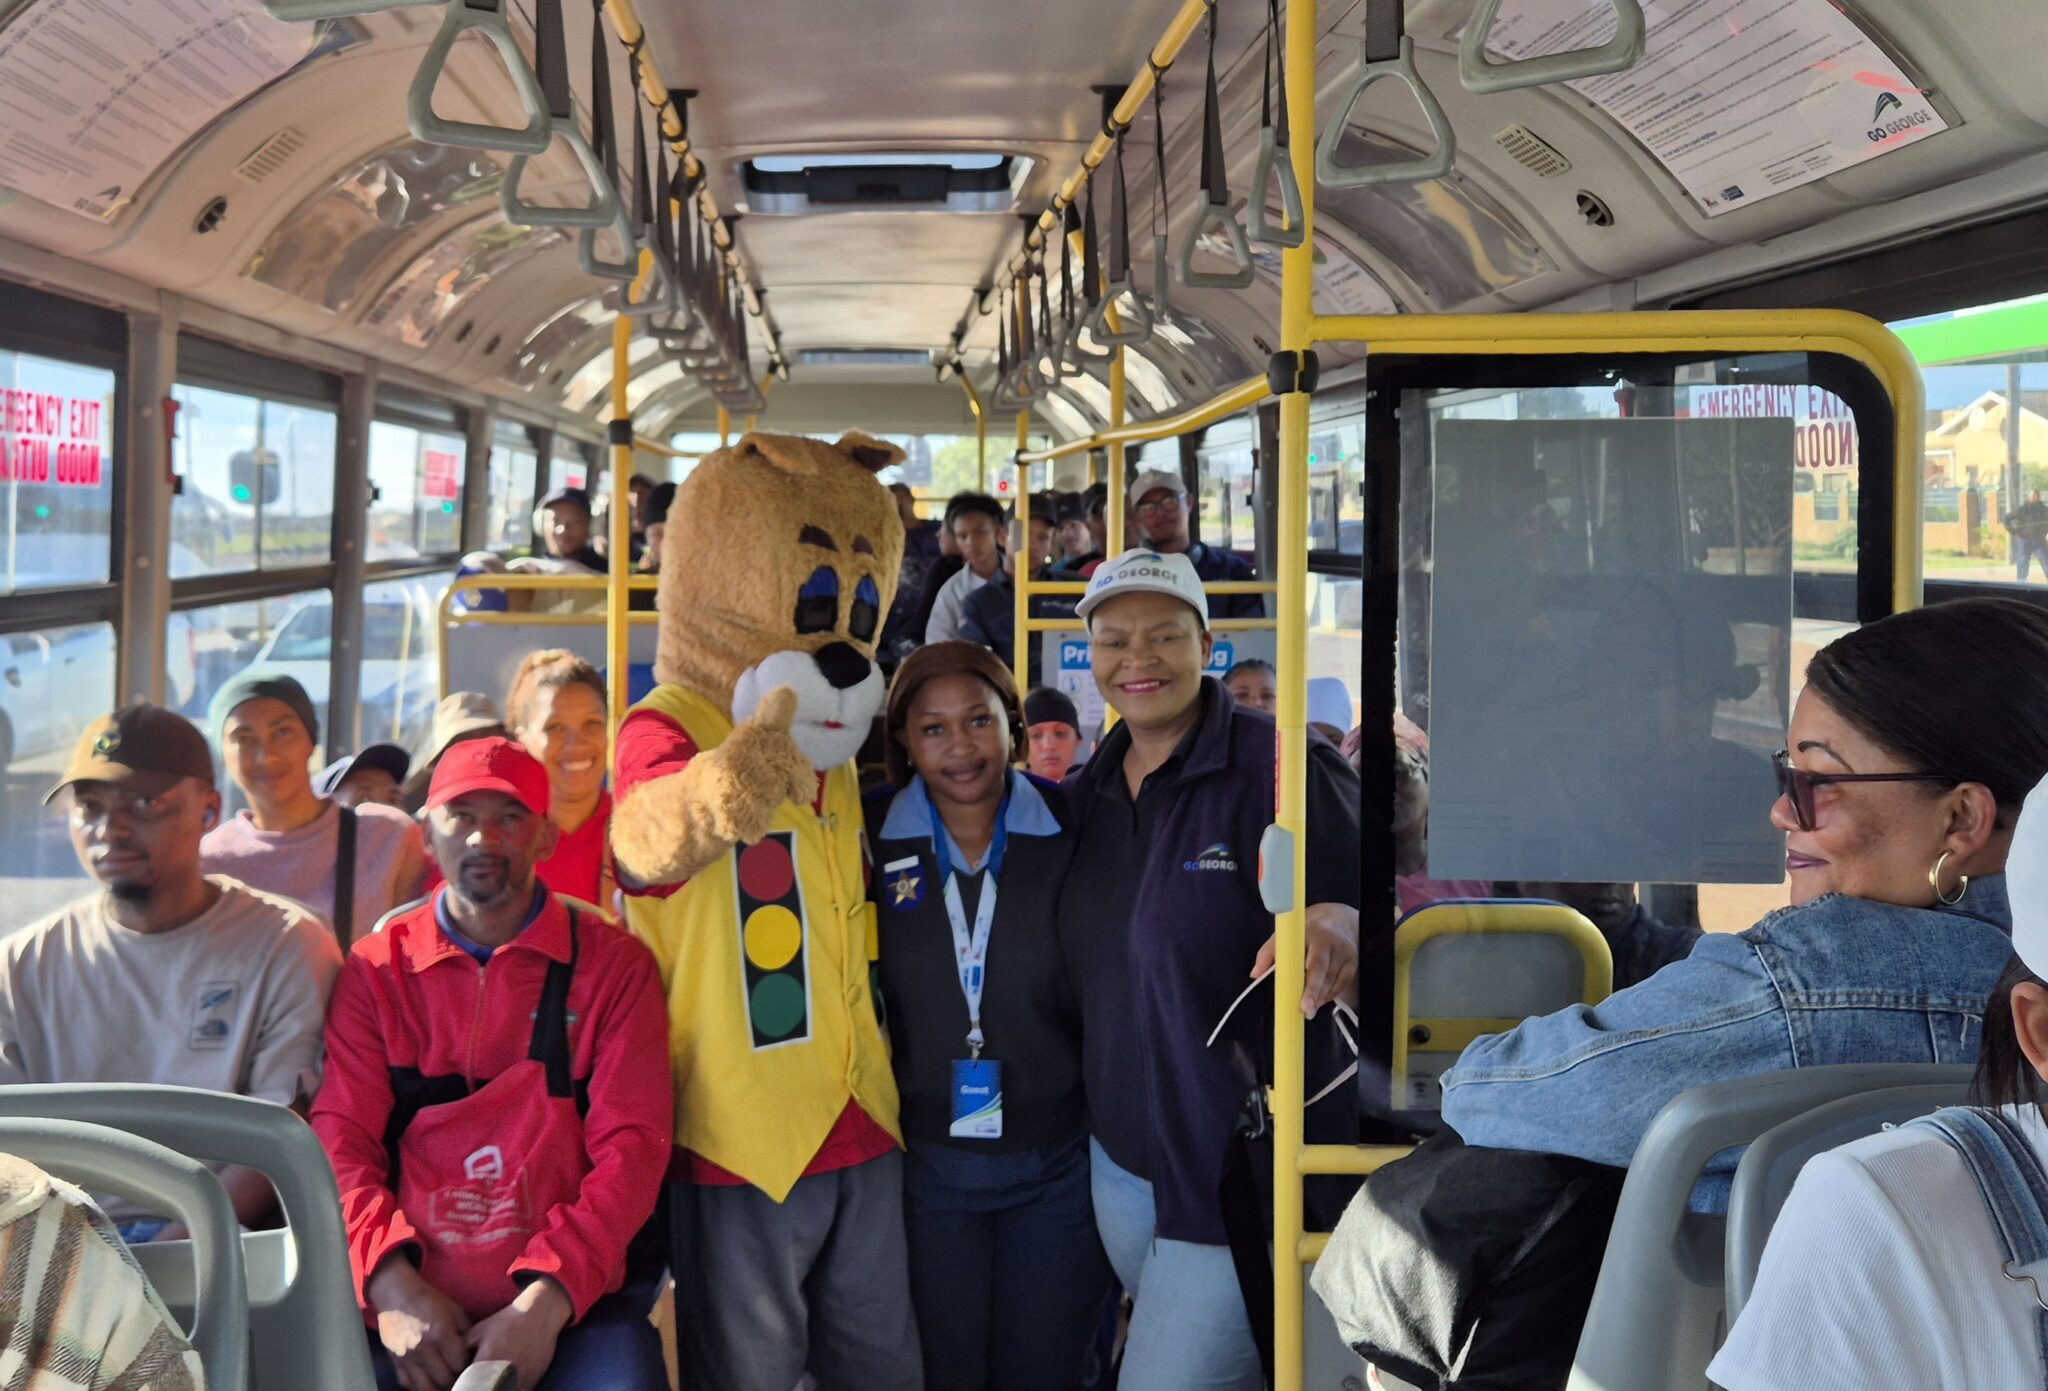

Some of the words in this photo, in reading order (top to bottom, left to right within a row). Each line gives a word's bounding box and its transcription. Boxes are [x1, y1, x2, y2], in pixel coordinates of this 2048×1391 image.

[1867, 127, 1887, 142] GO
[1886, 109, 1932, 135] GEORGE
[70, 399, 101, 440] EXIT
[1095, 575, 1114, 589] GO
[1118, 567, 1179, 585] GEORGE
